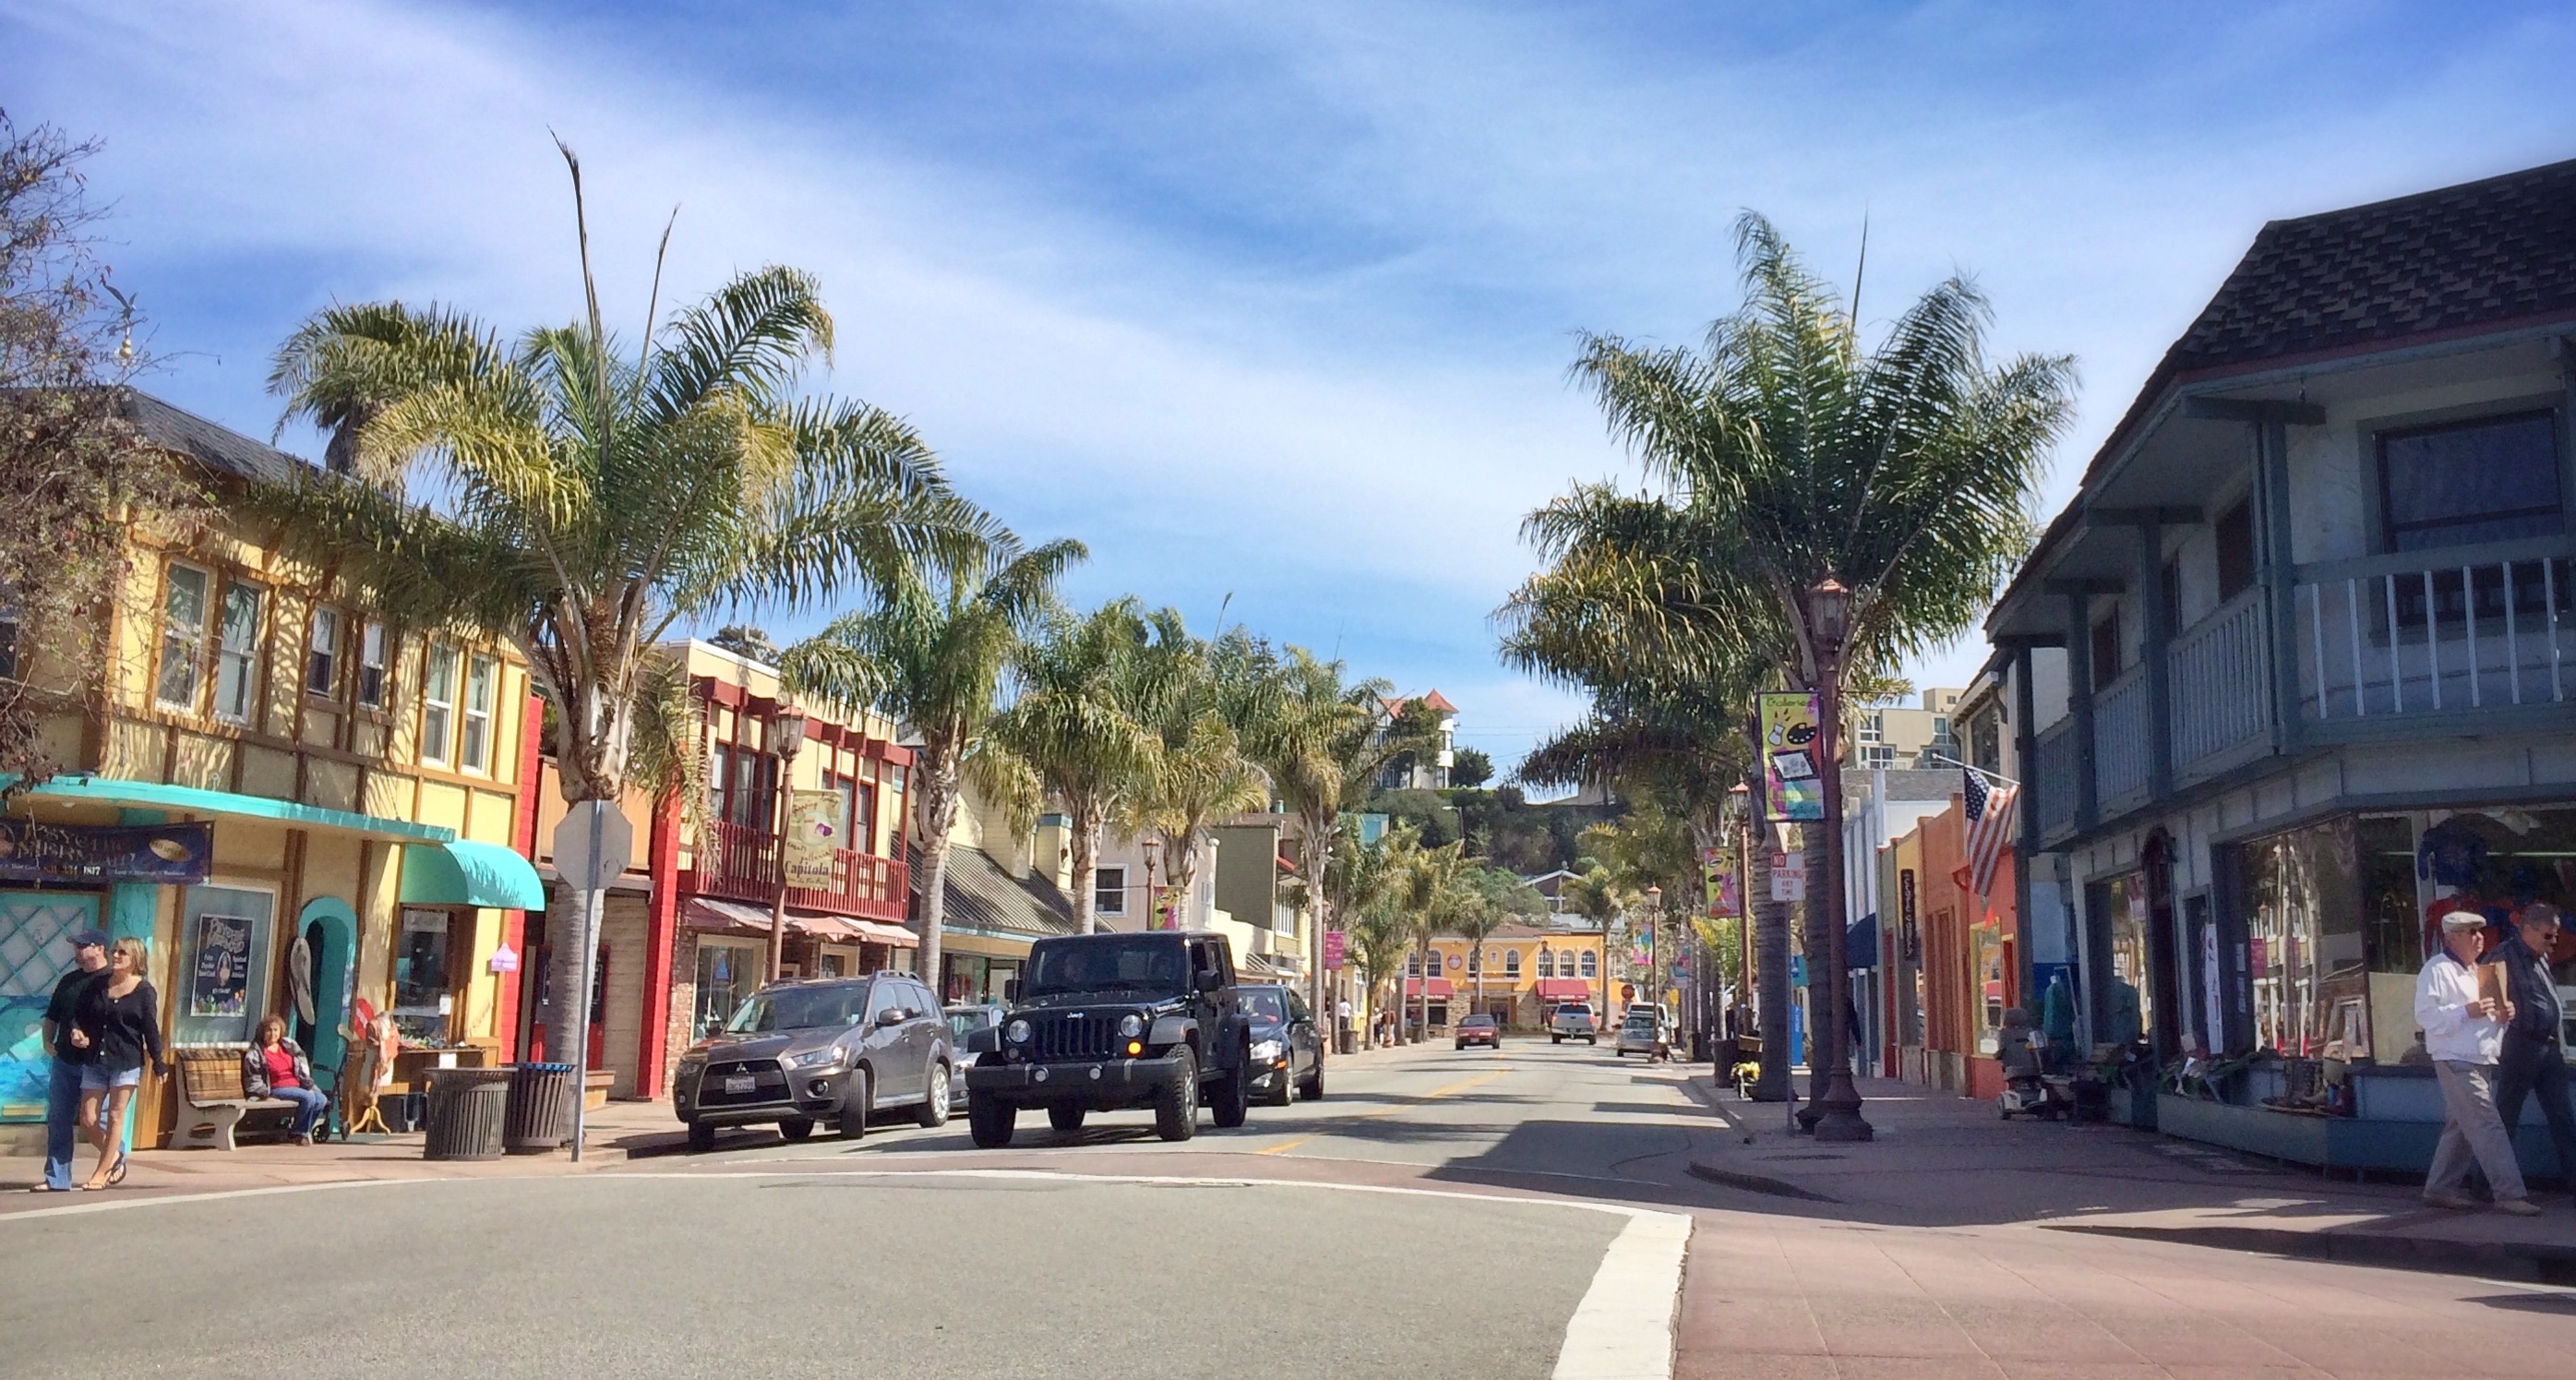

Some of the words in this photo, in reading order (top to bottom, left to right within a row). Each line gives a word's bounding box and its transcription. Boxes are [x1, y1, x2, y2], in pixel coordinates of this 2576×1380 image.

[1773, 855, 1785, 866] NO
[785, 860, 829, 878] Capitola
[1772, 869, 1803, 878] PARKING
